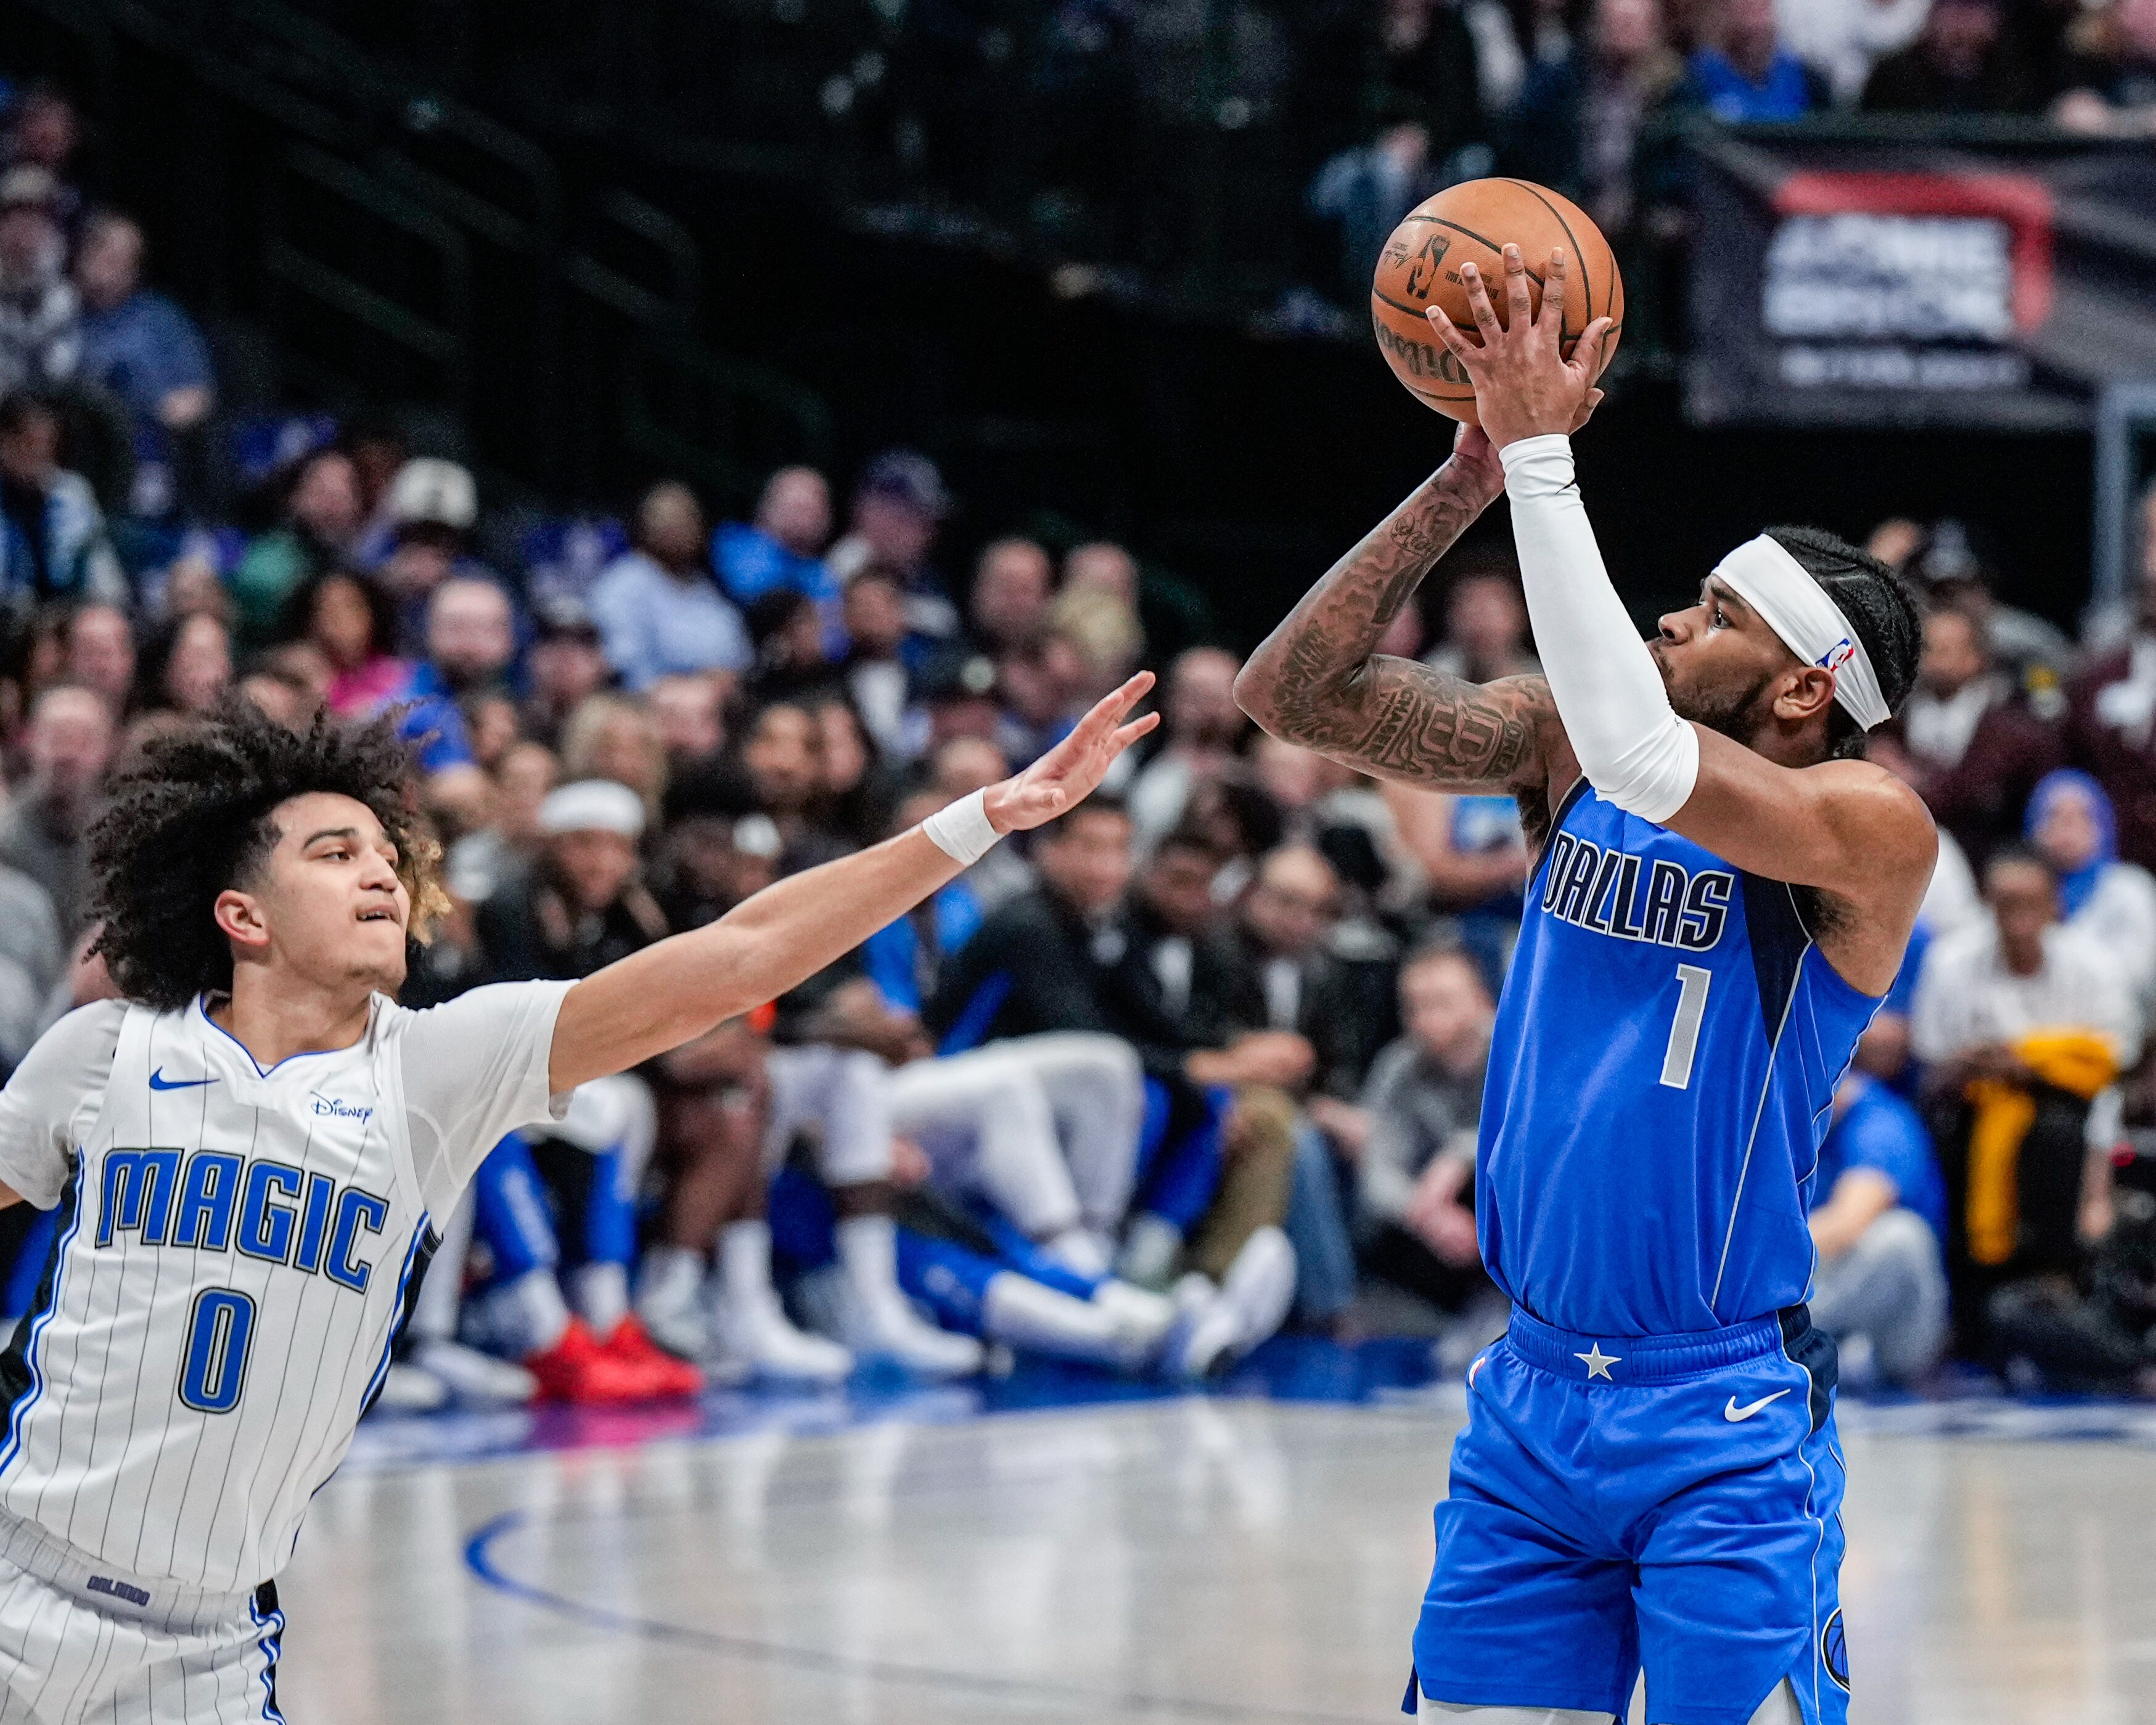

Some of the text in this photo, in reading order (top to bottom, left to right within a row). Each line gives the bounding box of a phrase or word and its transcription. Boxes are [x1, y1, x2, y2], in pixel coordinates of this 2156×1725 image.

[1541, 829, 1735, 952] DALLAS
[1659, 962, 1712, 1090] 1
[94, 1147, 390, 1295] MAGIC
[178, 1287, 257, 1415] 0
